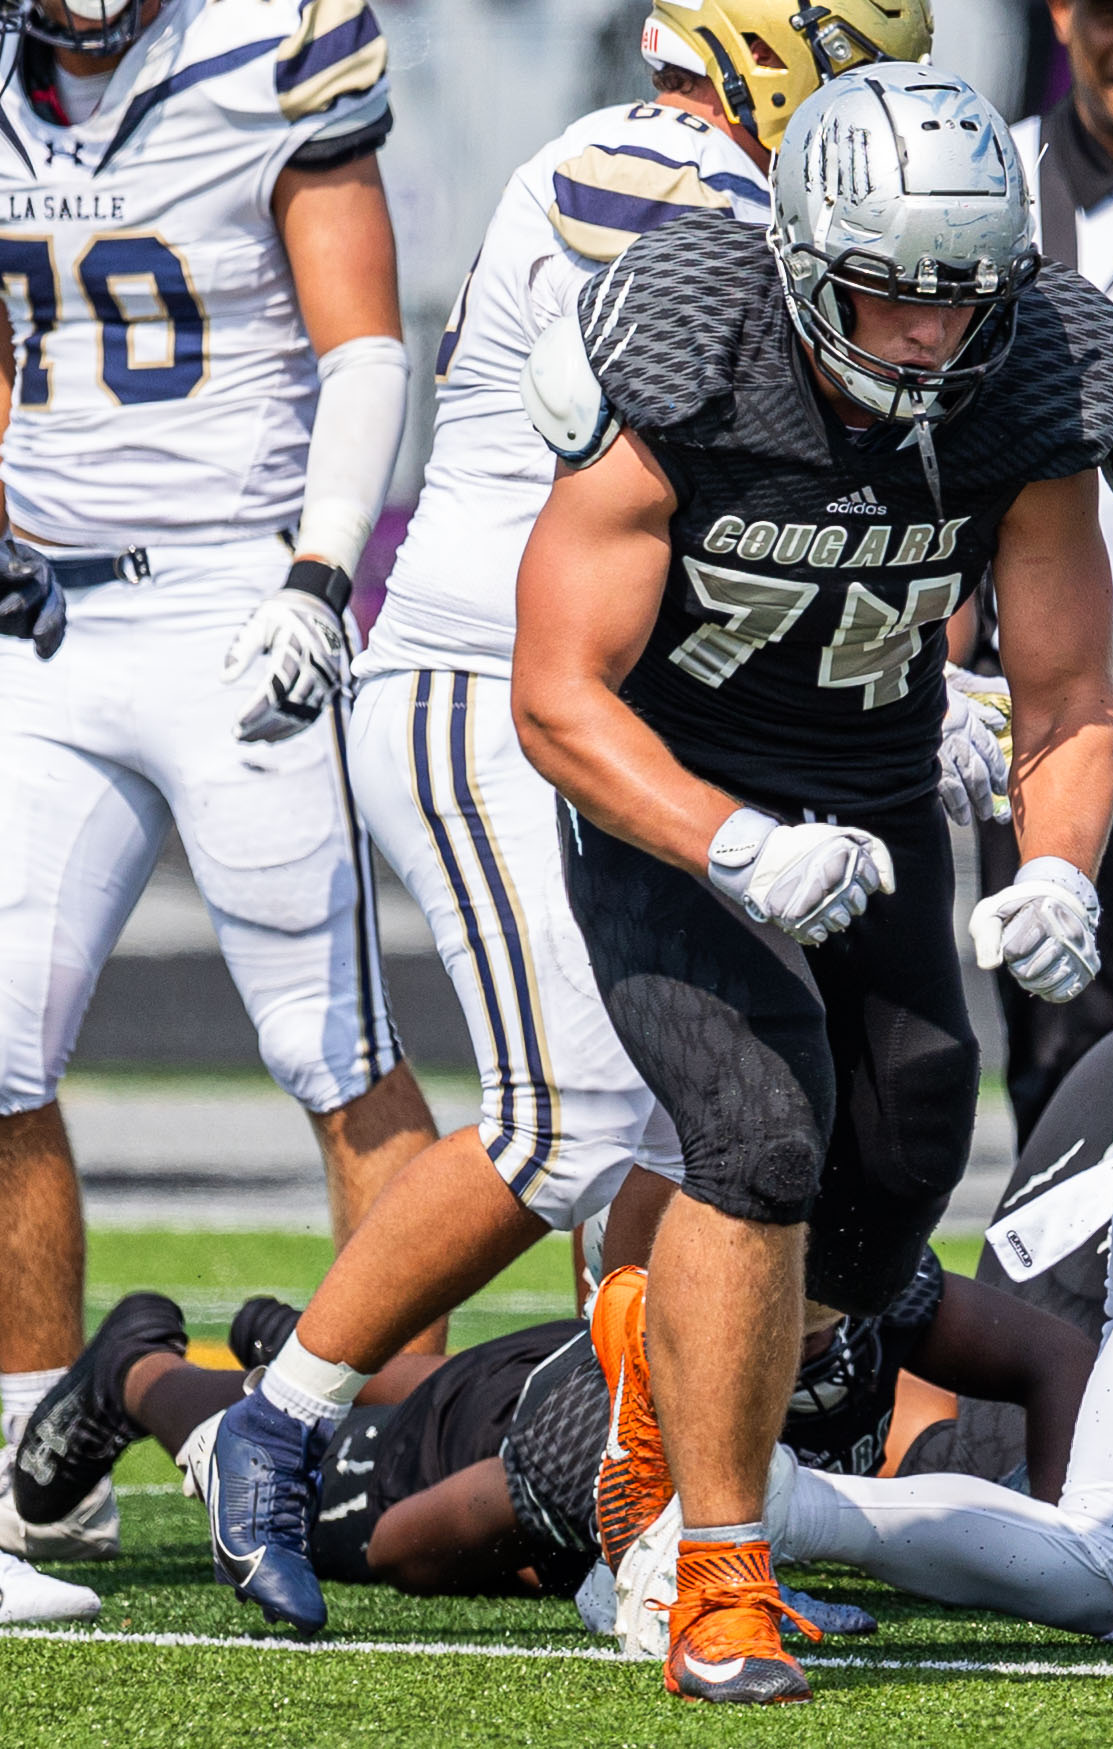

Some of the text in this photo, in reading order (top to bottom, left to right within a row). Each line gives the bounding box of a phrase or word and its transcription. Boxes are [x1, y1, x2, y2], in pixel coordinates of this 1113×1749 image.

[9, 196, 125, 220] LA SALLE
[826, 501, 887, 515] adidas
[703, 515, 971, 568] COUGARS
[668, 555, 962, 711] 74
